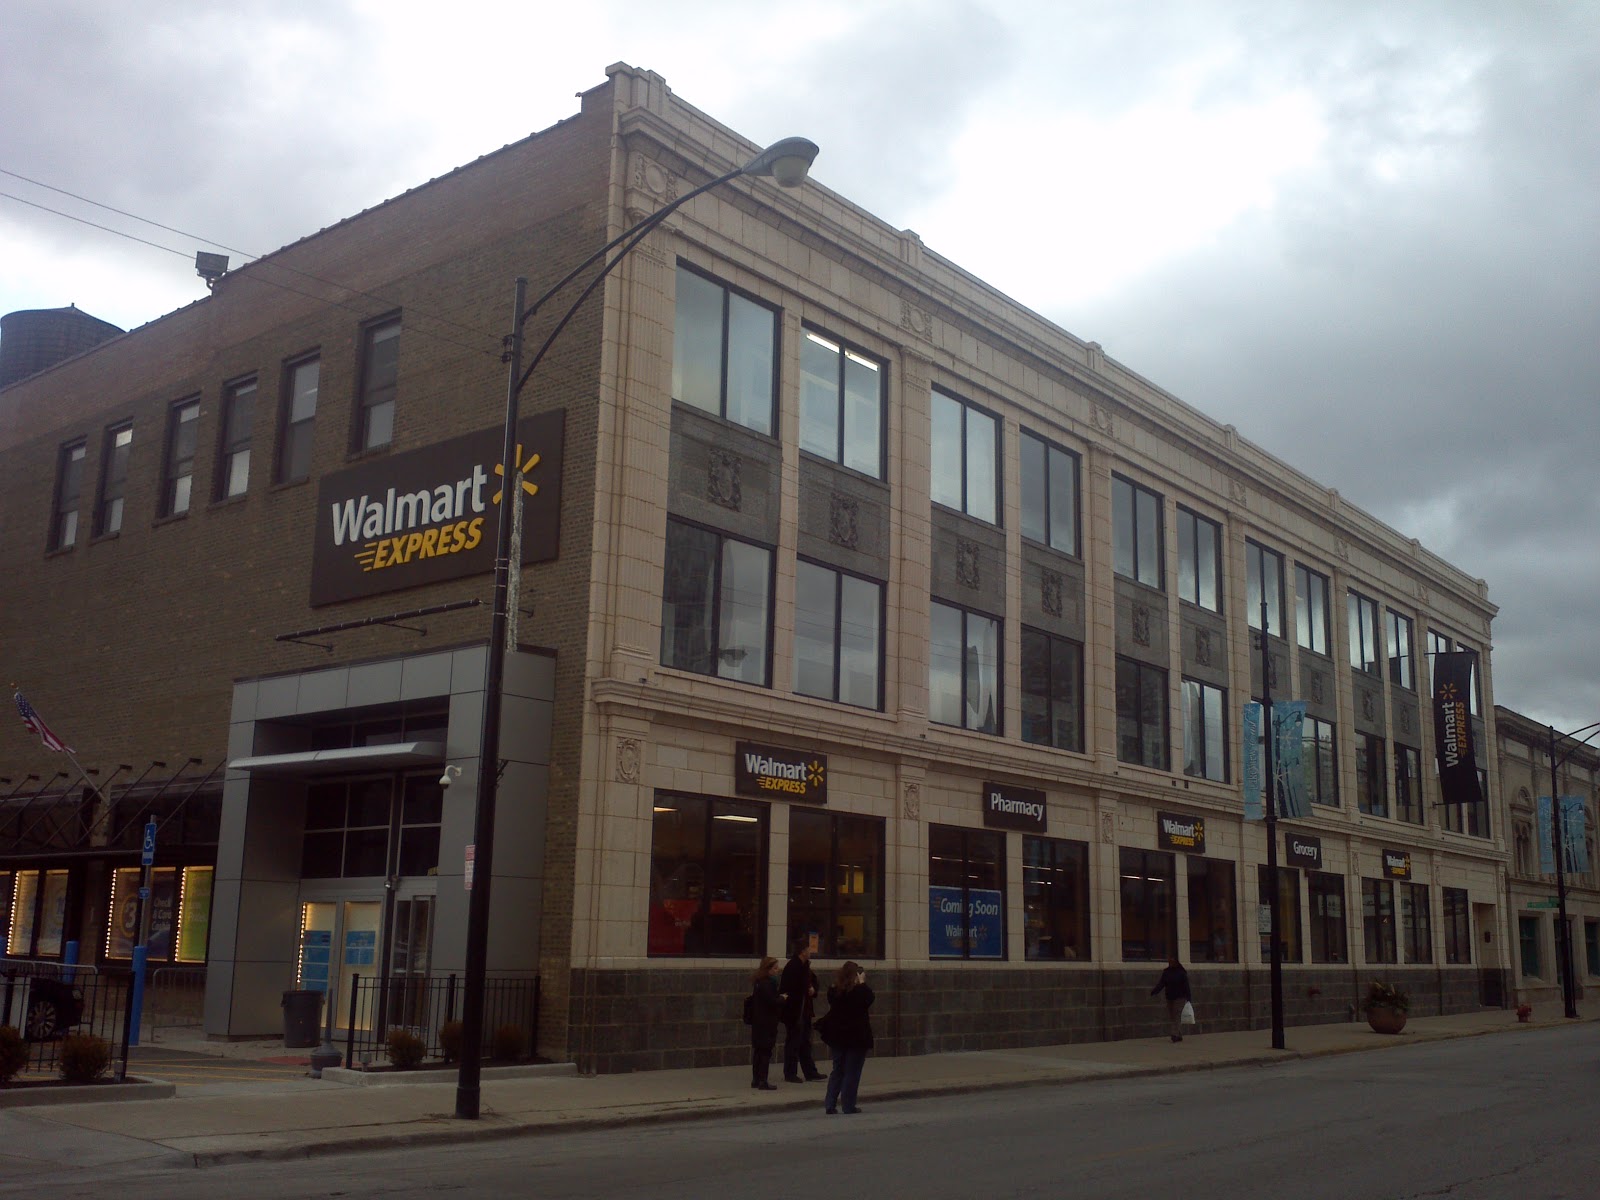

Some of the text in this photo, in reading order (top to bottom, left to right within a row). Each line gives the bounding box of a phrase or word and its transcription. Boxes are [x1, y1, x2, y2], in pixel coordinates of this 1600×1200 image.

[332, 464, 487, 547] Walmart
[373, 517, 486, 570] EXPRESS
[1442, 701, 1459, 768] Walmart
[1456, 701, 1467, 748] EXPRESS
[744, 753, 807, 781] Walmart
[765, 776, 807, 795] EXPRESS
[990, 792, 1044, 821] Pharmacy
[1162, 818, 1195, 837] Walmart
[1293, 840, 1318, 861] Grocery
[940, 897, 998, 918] Comig Soon
